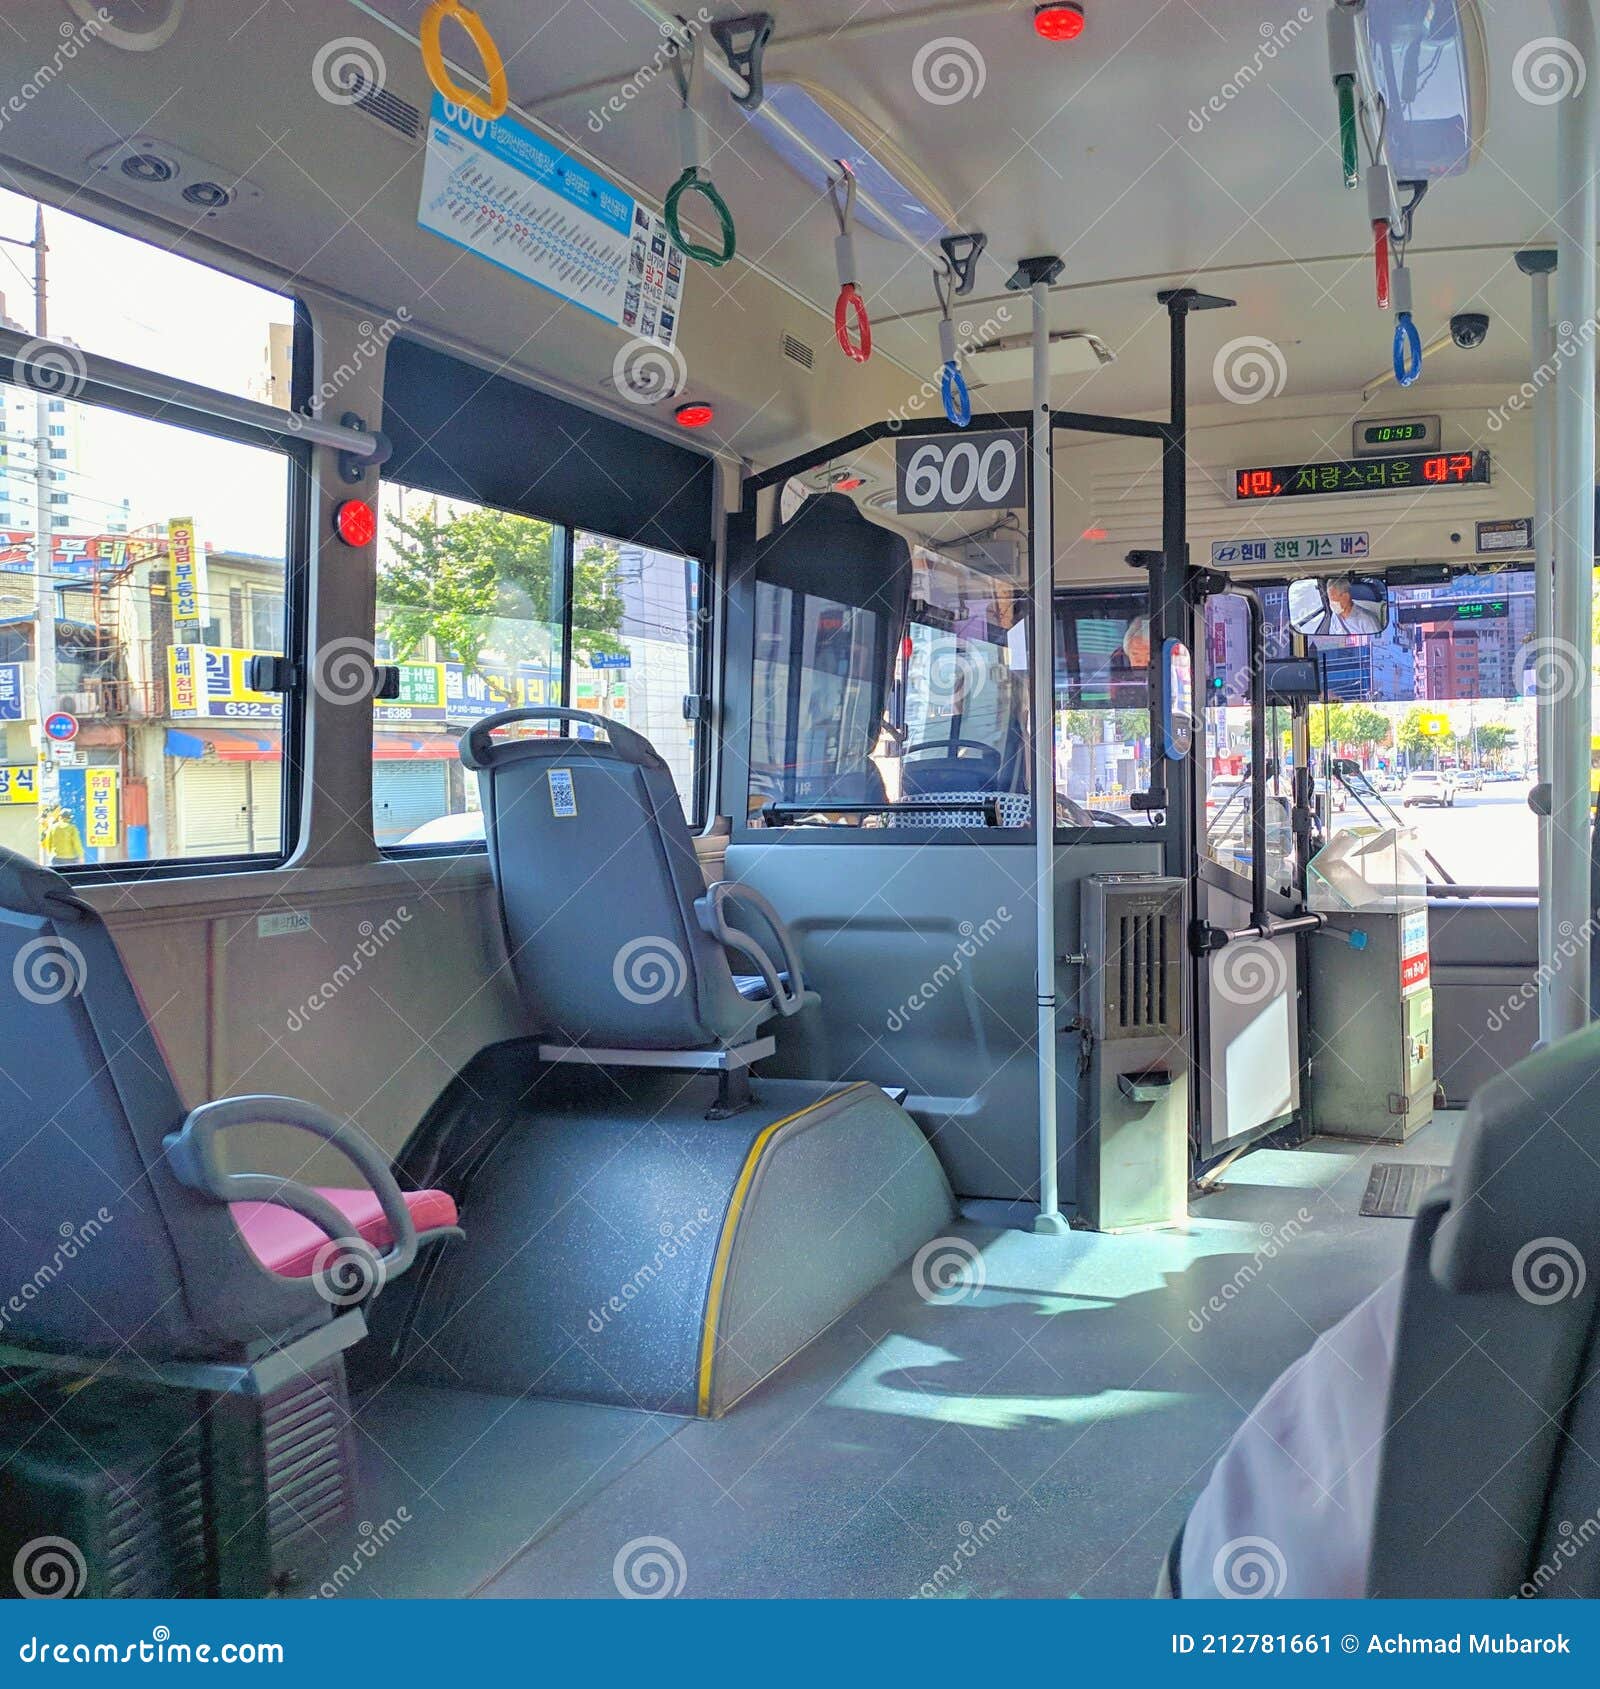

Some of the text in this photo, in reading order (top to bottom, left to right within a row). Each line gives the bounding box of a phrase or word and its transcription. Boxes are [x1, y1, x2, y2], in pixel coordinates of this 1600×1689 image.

[1378, 427, 1413, 440] 10:43
[905, 439, 1017, 507] 600
[1296, 461, 1412, 490] 자랑스러운
[1424, 455, 1472, 484] 대구
[1240, 536, 1367, 561] 현대 천연 가스 버스
[93, 791, 110, 836] 부동산
